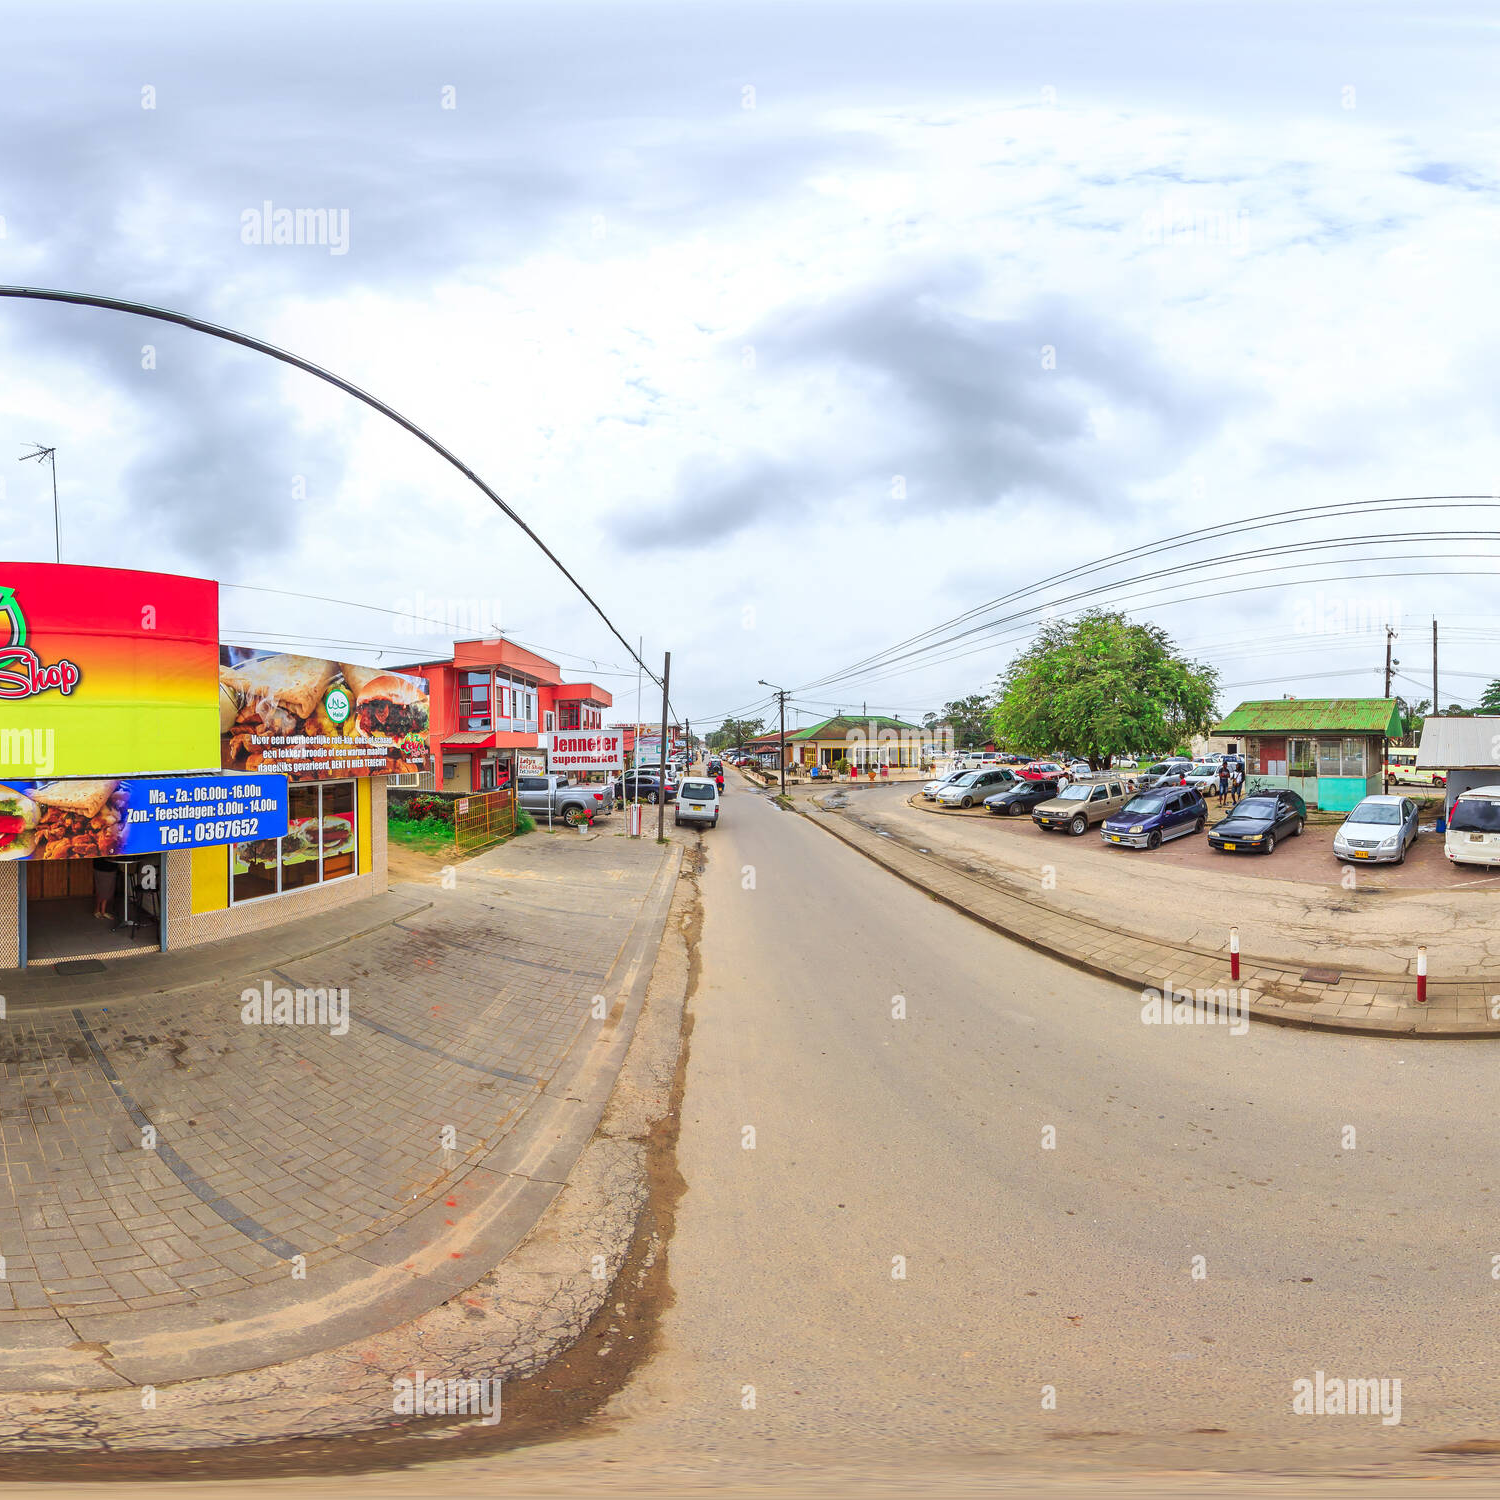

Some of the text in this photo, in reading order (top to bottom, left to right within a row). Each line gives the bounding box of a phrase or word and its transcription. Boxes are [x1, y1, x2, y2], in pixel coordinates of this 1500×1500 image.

[251, 734, 269, 745] Voor
[271, 736, 285, 745] een
[553, 736, 618, 752] Jennefer
[262, 749, 277, 759] een
[278, 748, 301, 758] lekker
[552, 754, 619, 766] supermarket
[331, 759, 346, 769] BENT
[149, 790, 168, 804] Ma.
[176, 788, 192, 802] Za.:
[194, 787, 228, 802] 06.00u
[155, 805, 216, 821] feestdagen:
[217, 801, 244, 816] 8.00u
[250, 799, 277, 812] 14.00u
[159, 818, 259, 845] Tel.: 0367652
